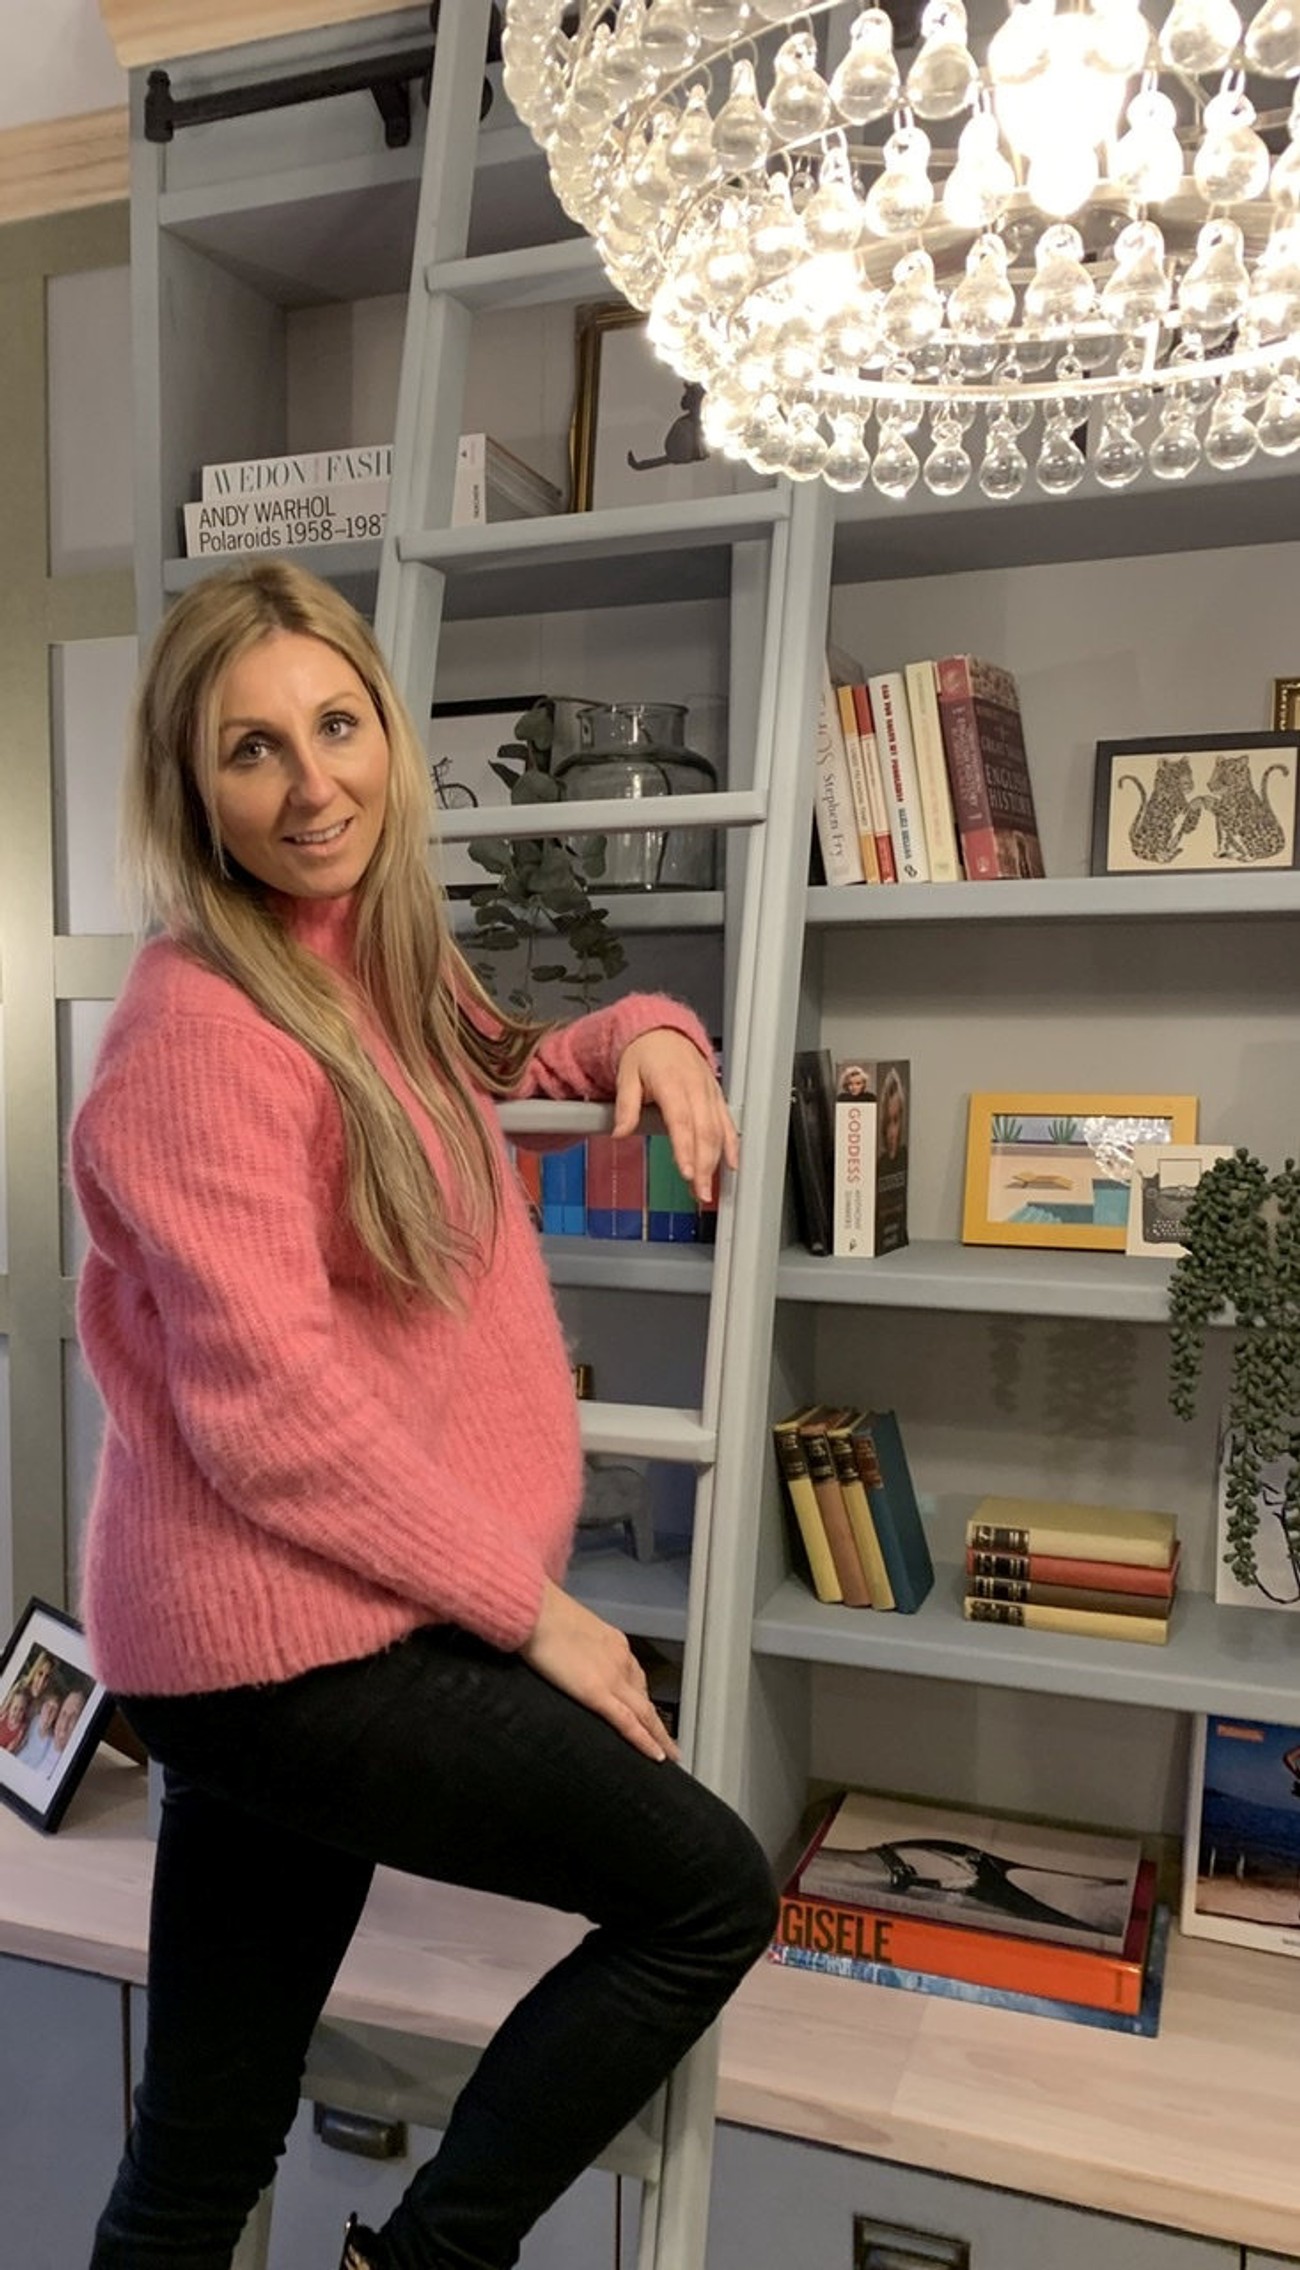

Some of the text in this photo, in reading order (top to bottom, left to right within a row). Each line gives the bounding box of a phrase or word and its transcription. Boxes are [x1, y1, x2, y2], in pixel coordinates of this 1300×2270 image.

[200, 496, 336, 529] ANDY WARHOL
[200, 514, 387, 553] Polaroids 1958–198
[823, 769, 838, 829] Stephen
[833, 834, 843, 858] Fry
[848, 1108, 861, 1184] GODDESS
[782, 1904, 893, 1962] GISELE
